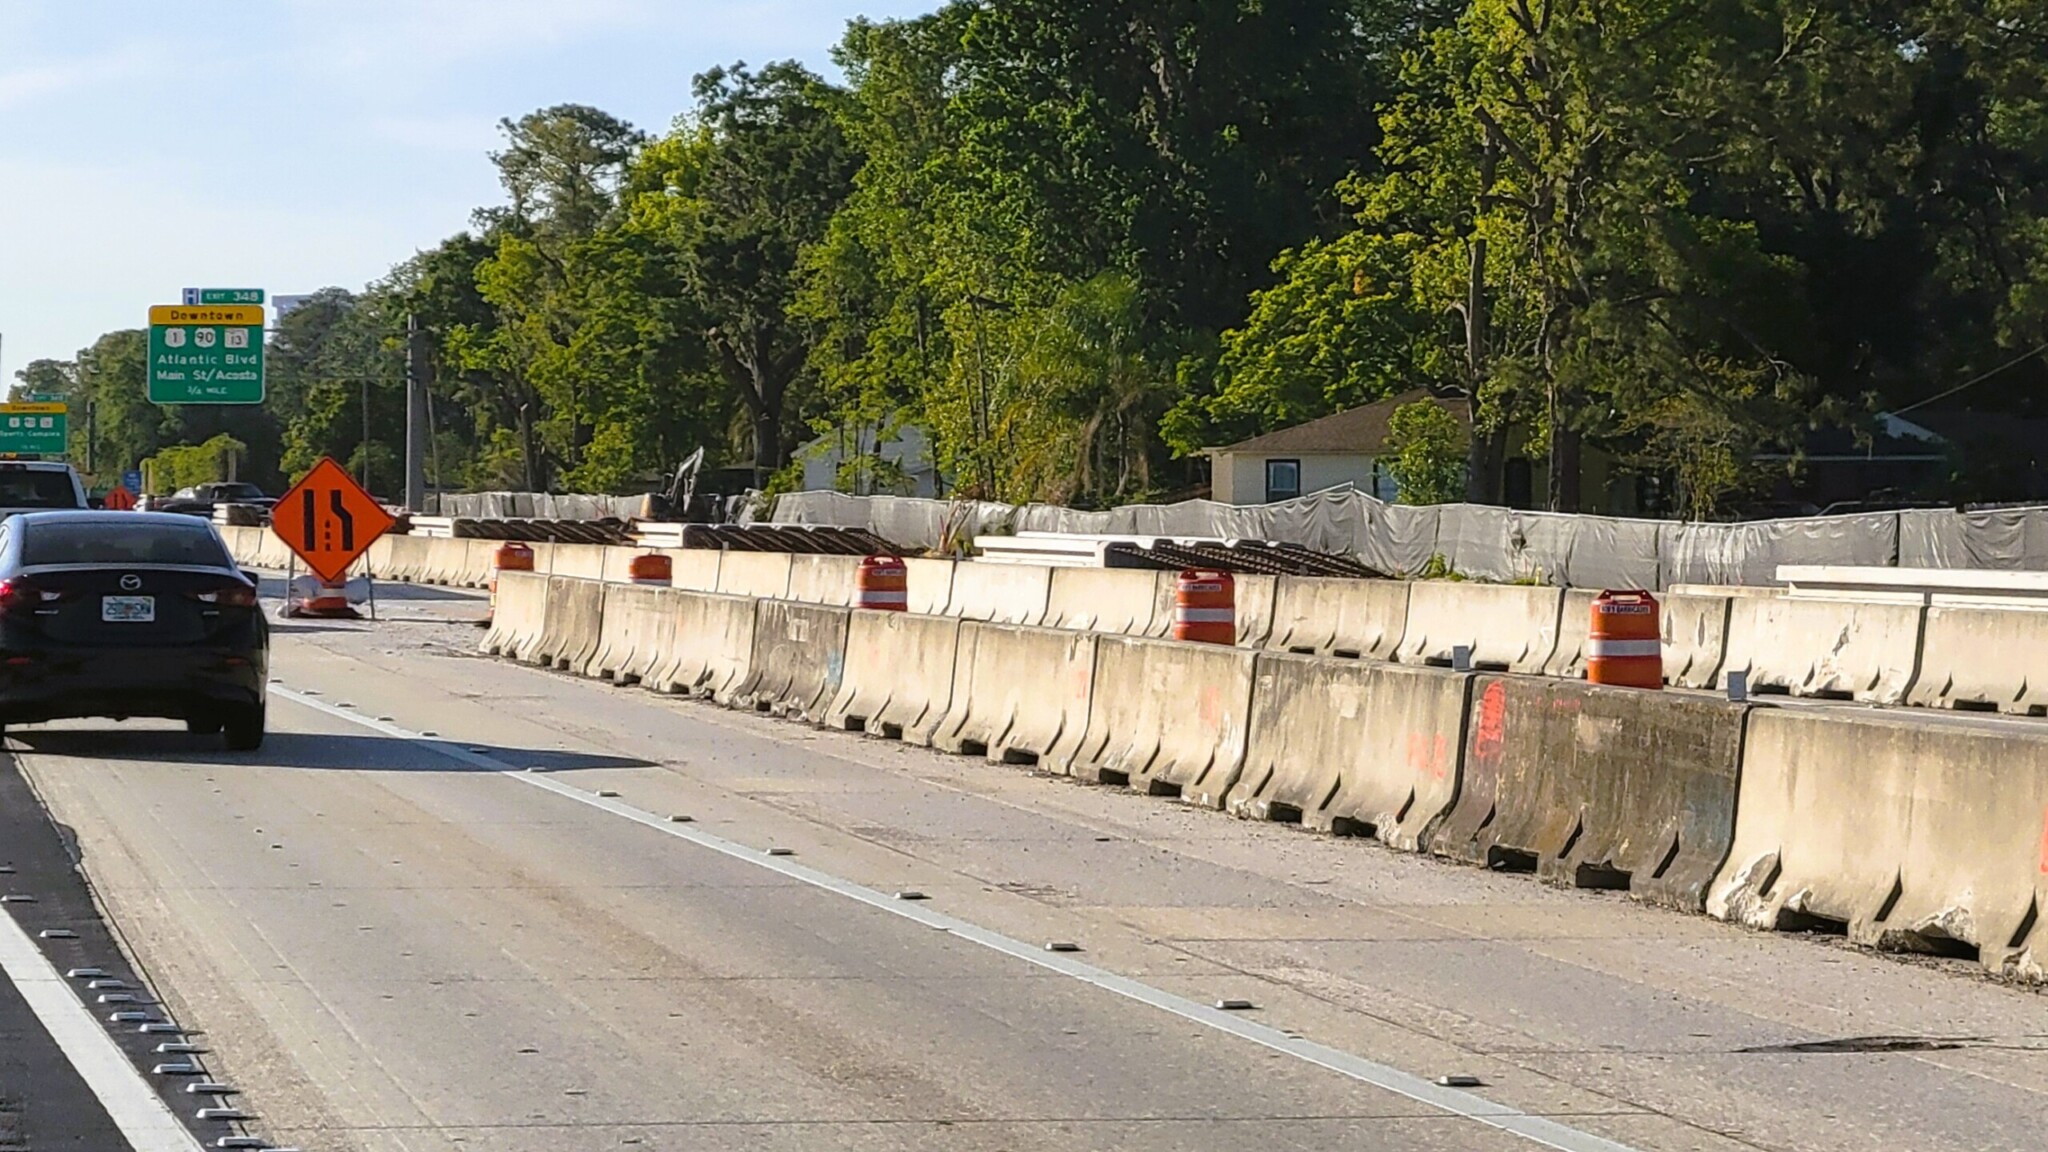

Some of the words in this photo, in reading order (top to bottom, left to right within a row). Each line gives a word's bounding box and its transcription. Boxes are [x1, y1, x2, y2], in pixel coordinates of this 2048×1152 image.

[232, 292, 258, 302] 348
[171, 310, 244, 320] Downtown
[172, 332, 178, 343] 1
[196, 331, 214, 343] 90
[230, 335, 242, 345] 13
[157, 354, 218, 365] Atlantic
[225, 354, 257, 365] Blvd
[156, 370, 185, 380] Main
[192, 368, 258, 382] St/Acosta
[206, 387, 227, 395] MILE
